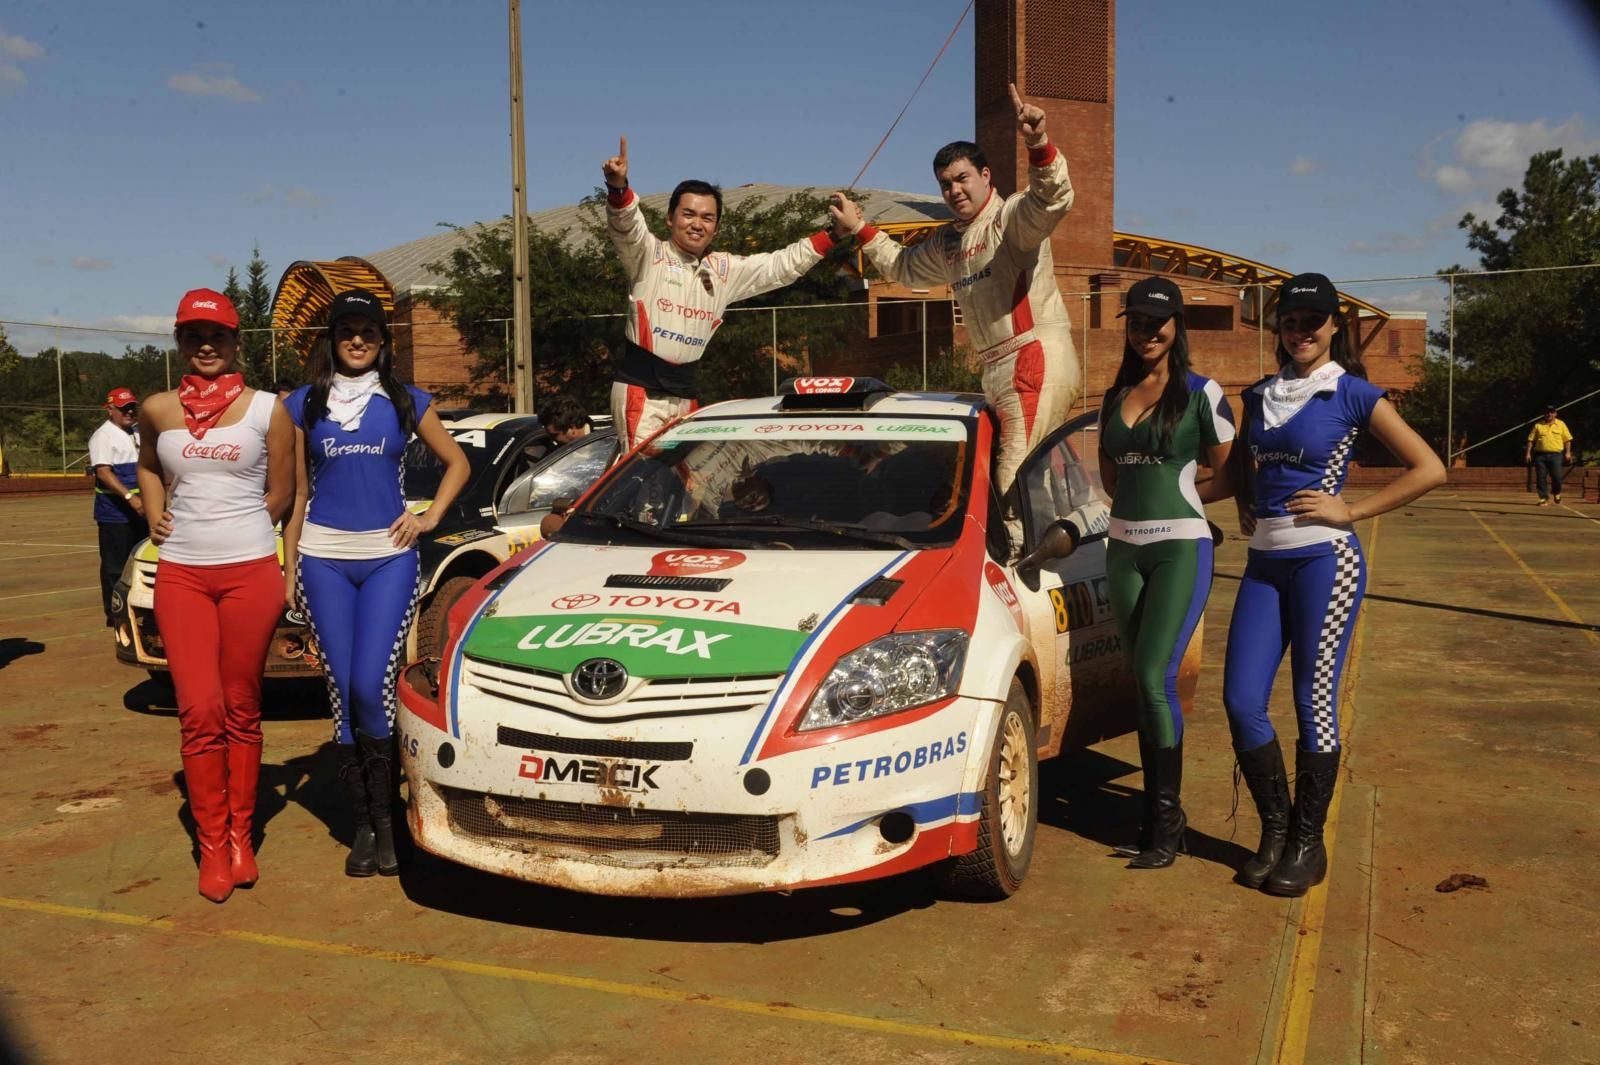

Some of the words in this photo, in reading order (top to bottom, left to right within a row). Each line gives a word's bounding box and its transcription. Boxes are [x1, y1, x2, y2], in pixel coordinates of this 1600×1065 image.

[951, 267, 992, 292] ETOBRAS
[801, 378, 846, 387] VOX
[676, 425, 744, 435] LUBRAX
[788, 424, 864, 433] TOYOTA
[875, 424, 952, 435] LUBRAX
[321, 437, 386, 458] Personal
[1250, 445, 1304, 468] Personal
[1124, 526, 1172, 536] PETROBRAS
[665, 554, 731, 565] VOX
[608, 594, 741, 615] TOYOTA
[517, 621, 732, 659] LUBRAX
[810, 731, 968, 789] PETROBRAS
